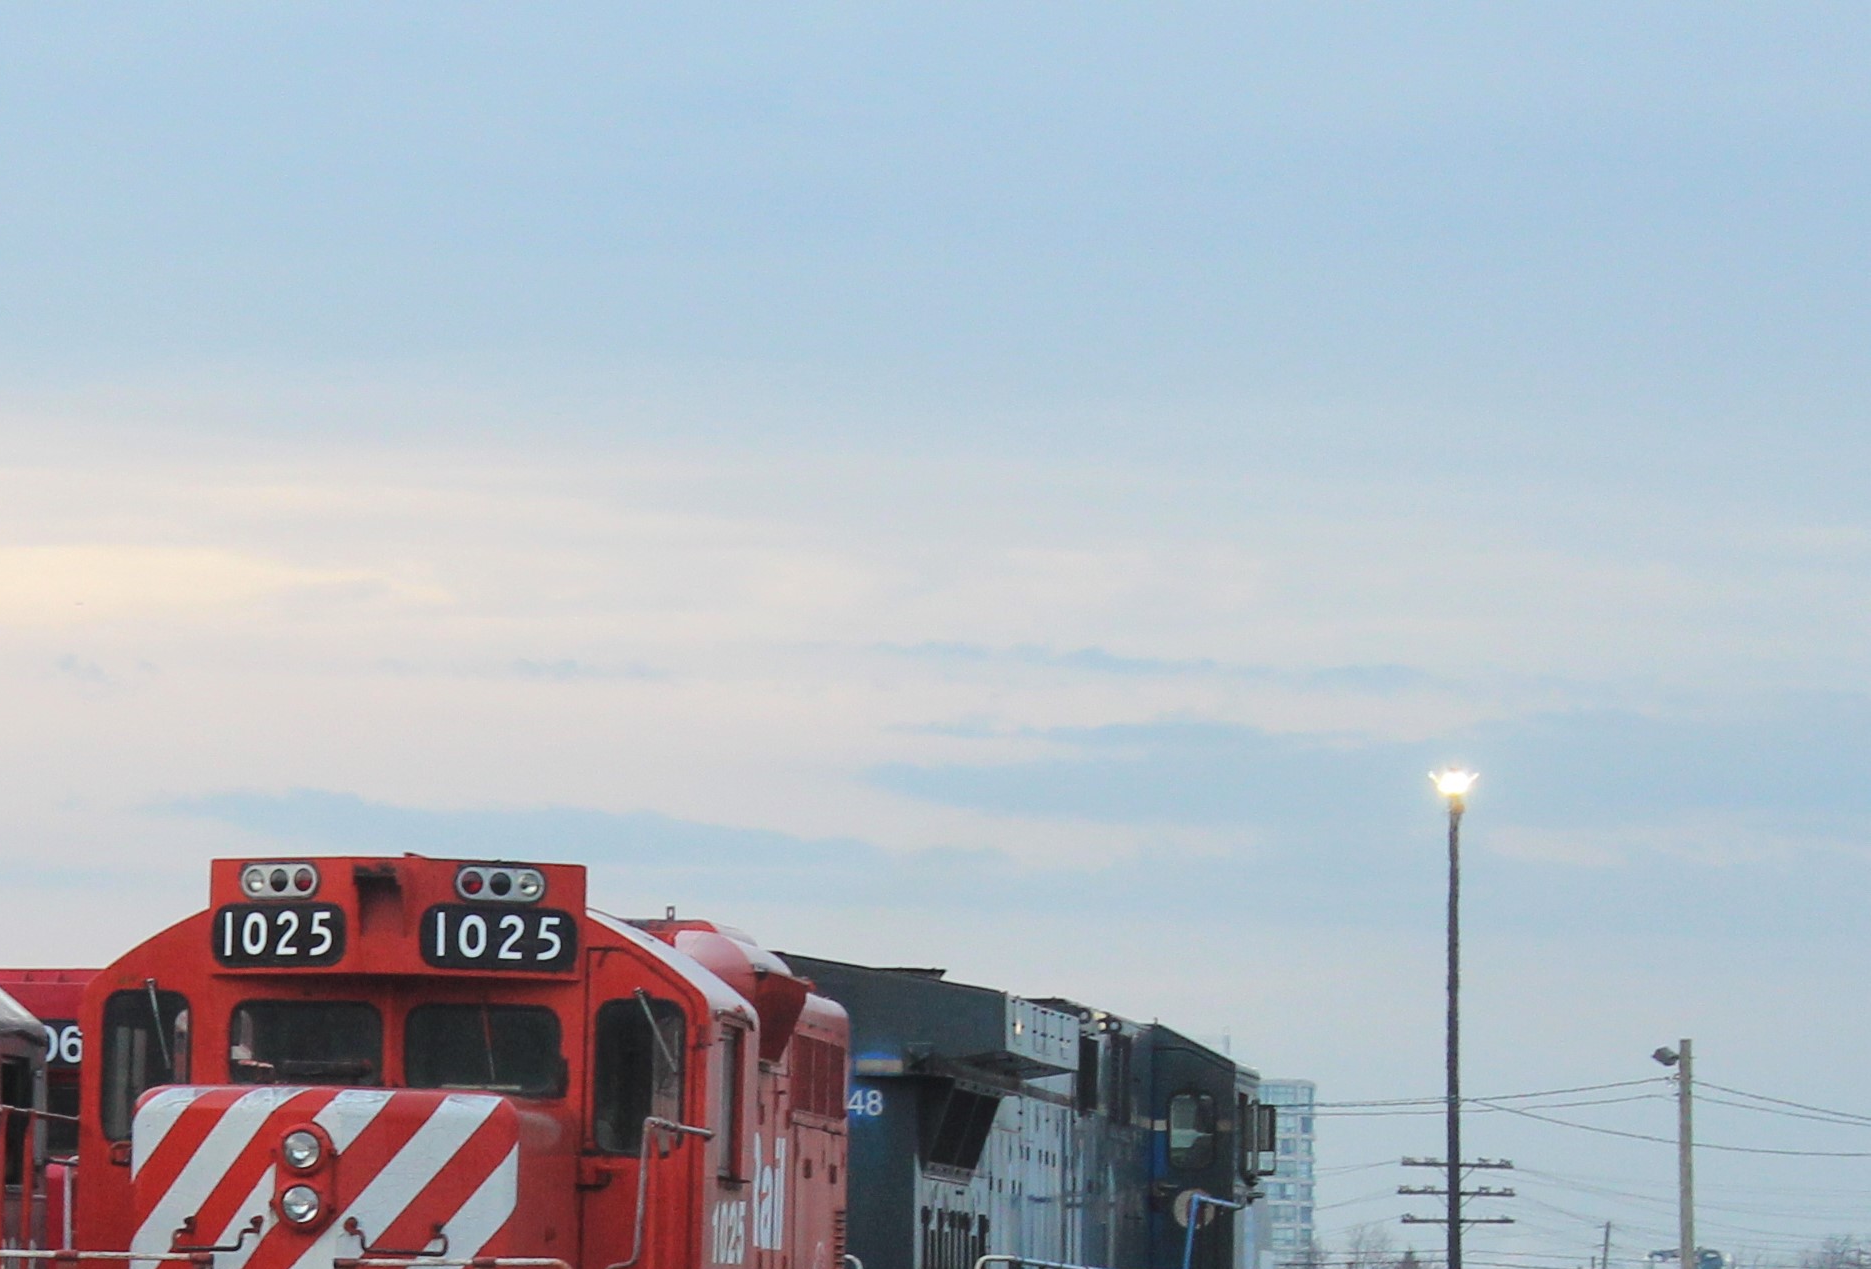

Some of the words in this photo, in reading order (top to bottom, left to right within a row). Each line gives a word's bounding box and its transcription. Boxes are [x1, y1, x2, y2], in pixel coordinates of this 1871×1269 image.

[224, 910, 333, 957] 1025
[436, 911, 562, 961] 1025
[846, 1089, 884, 1116] 48
[712, 1200, 746, 1265] 1025
